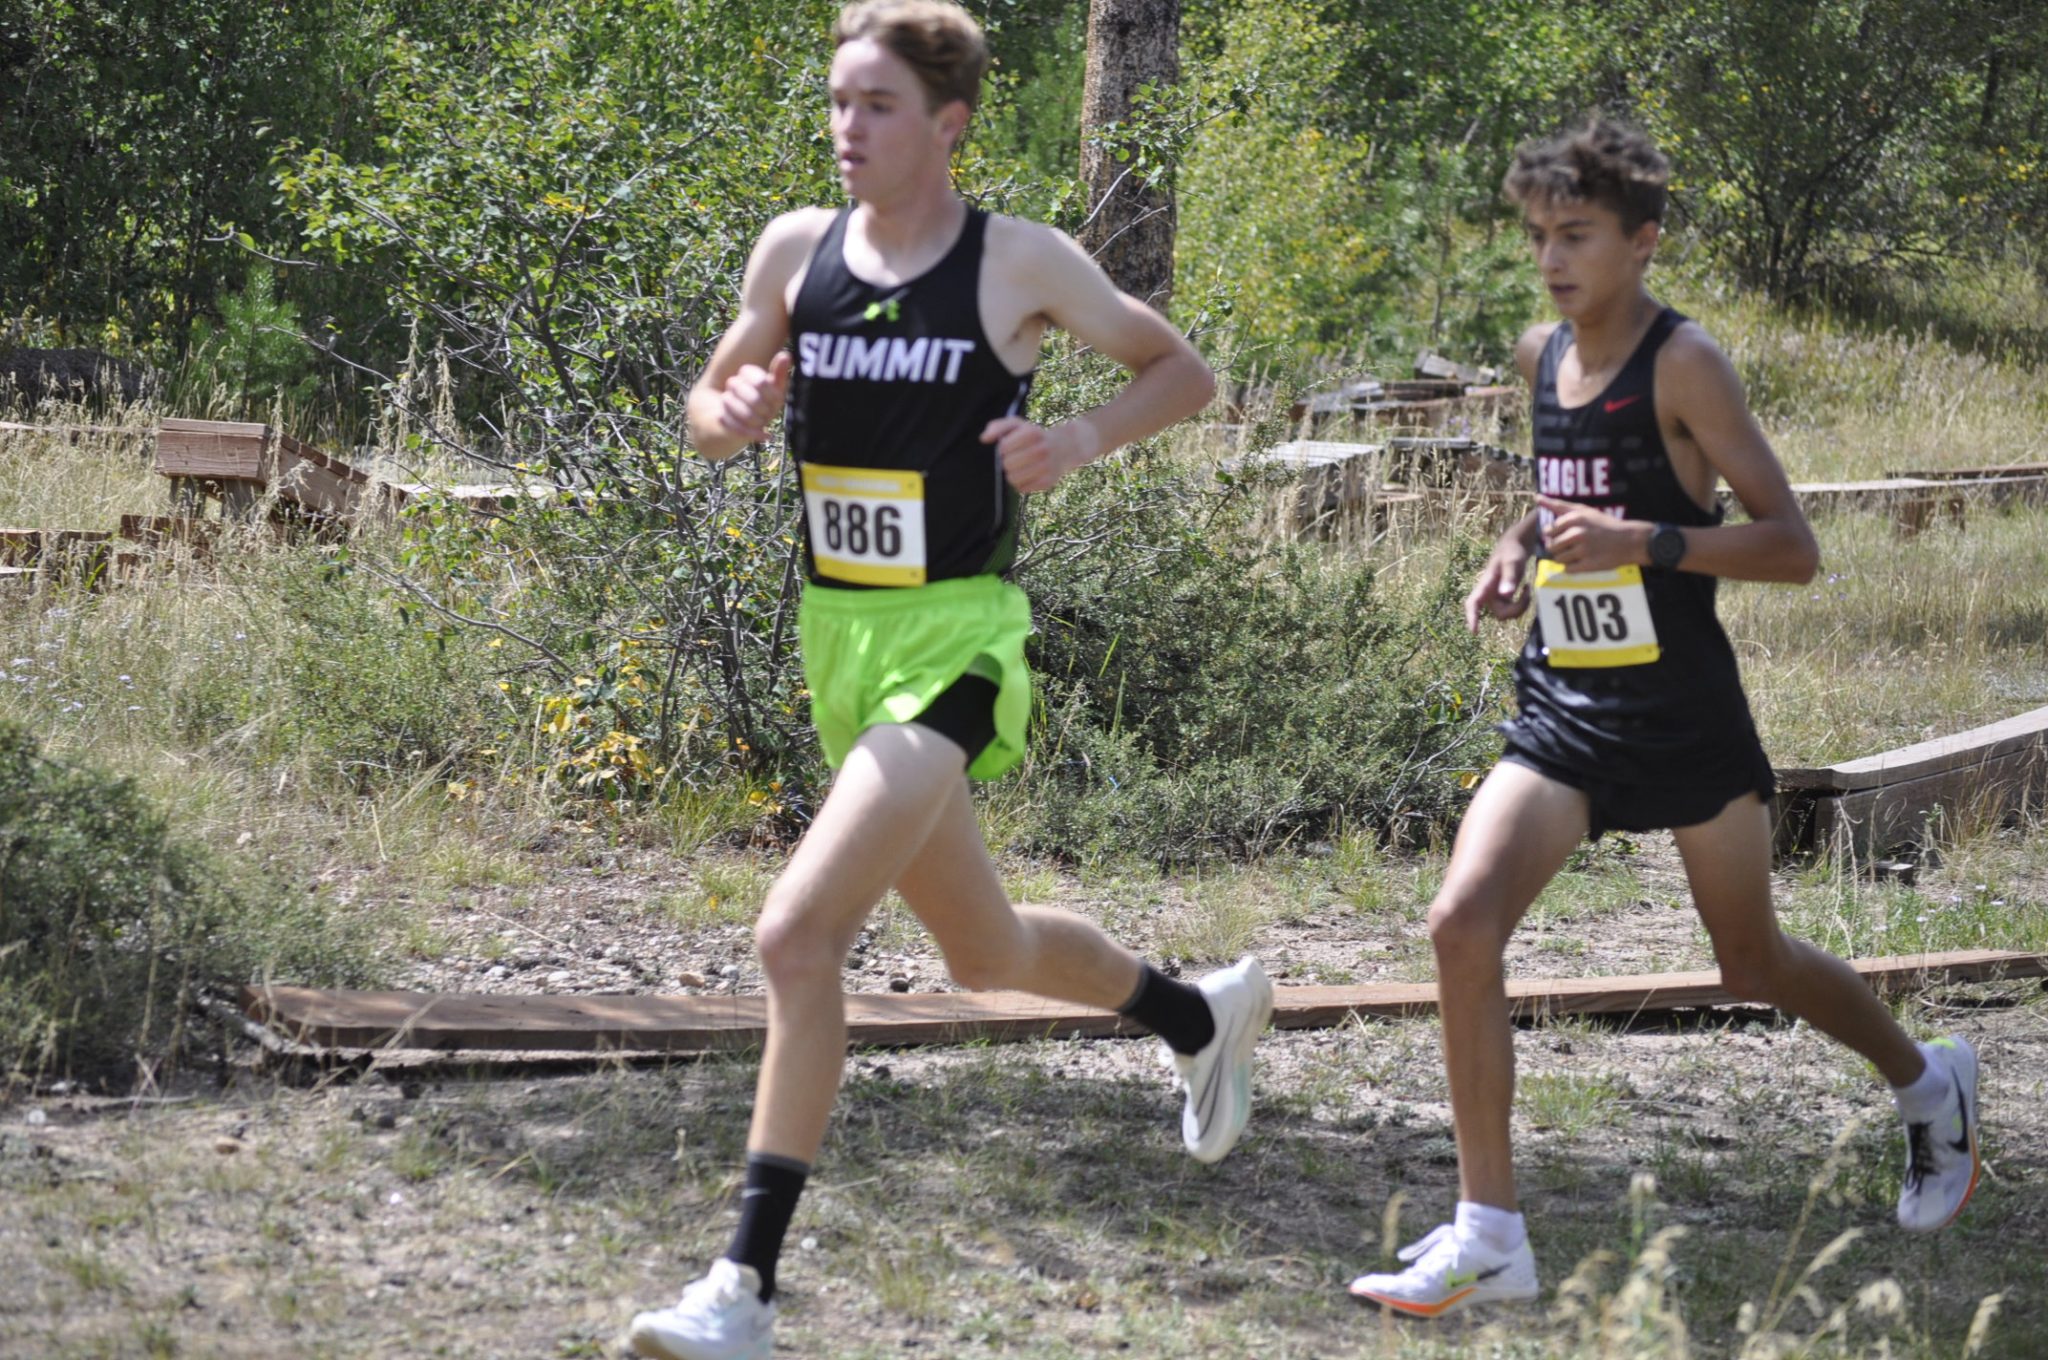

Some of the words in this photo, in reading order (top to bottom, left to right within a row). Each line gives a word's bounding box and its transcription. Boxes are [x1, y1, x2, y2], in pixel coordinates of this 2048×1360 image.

[799, 331, 976, 384] SUMMIT
[1537, 456, 1611, 497] EAGLE
[823, 497, 902, 558] 886
[1554, 592, 1629, 644] 103
